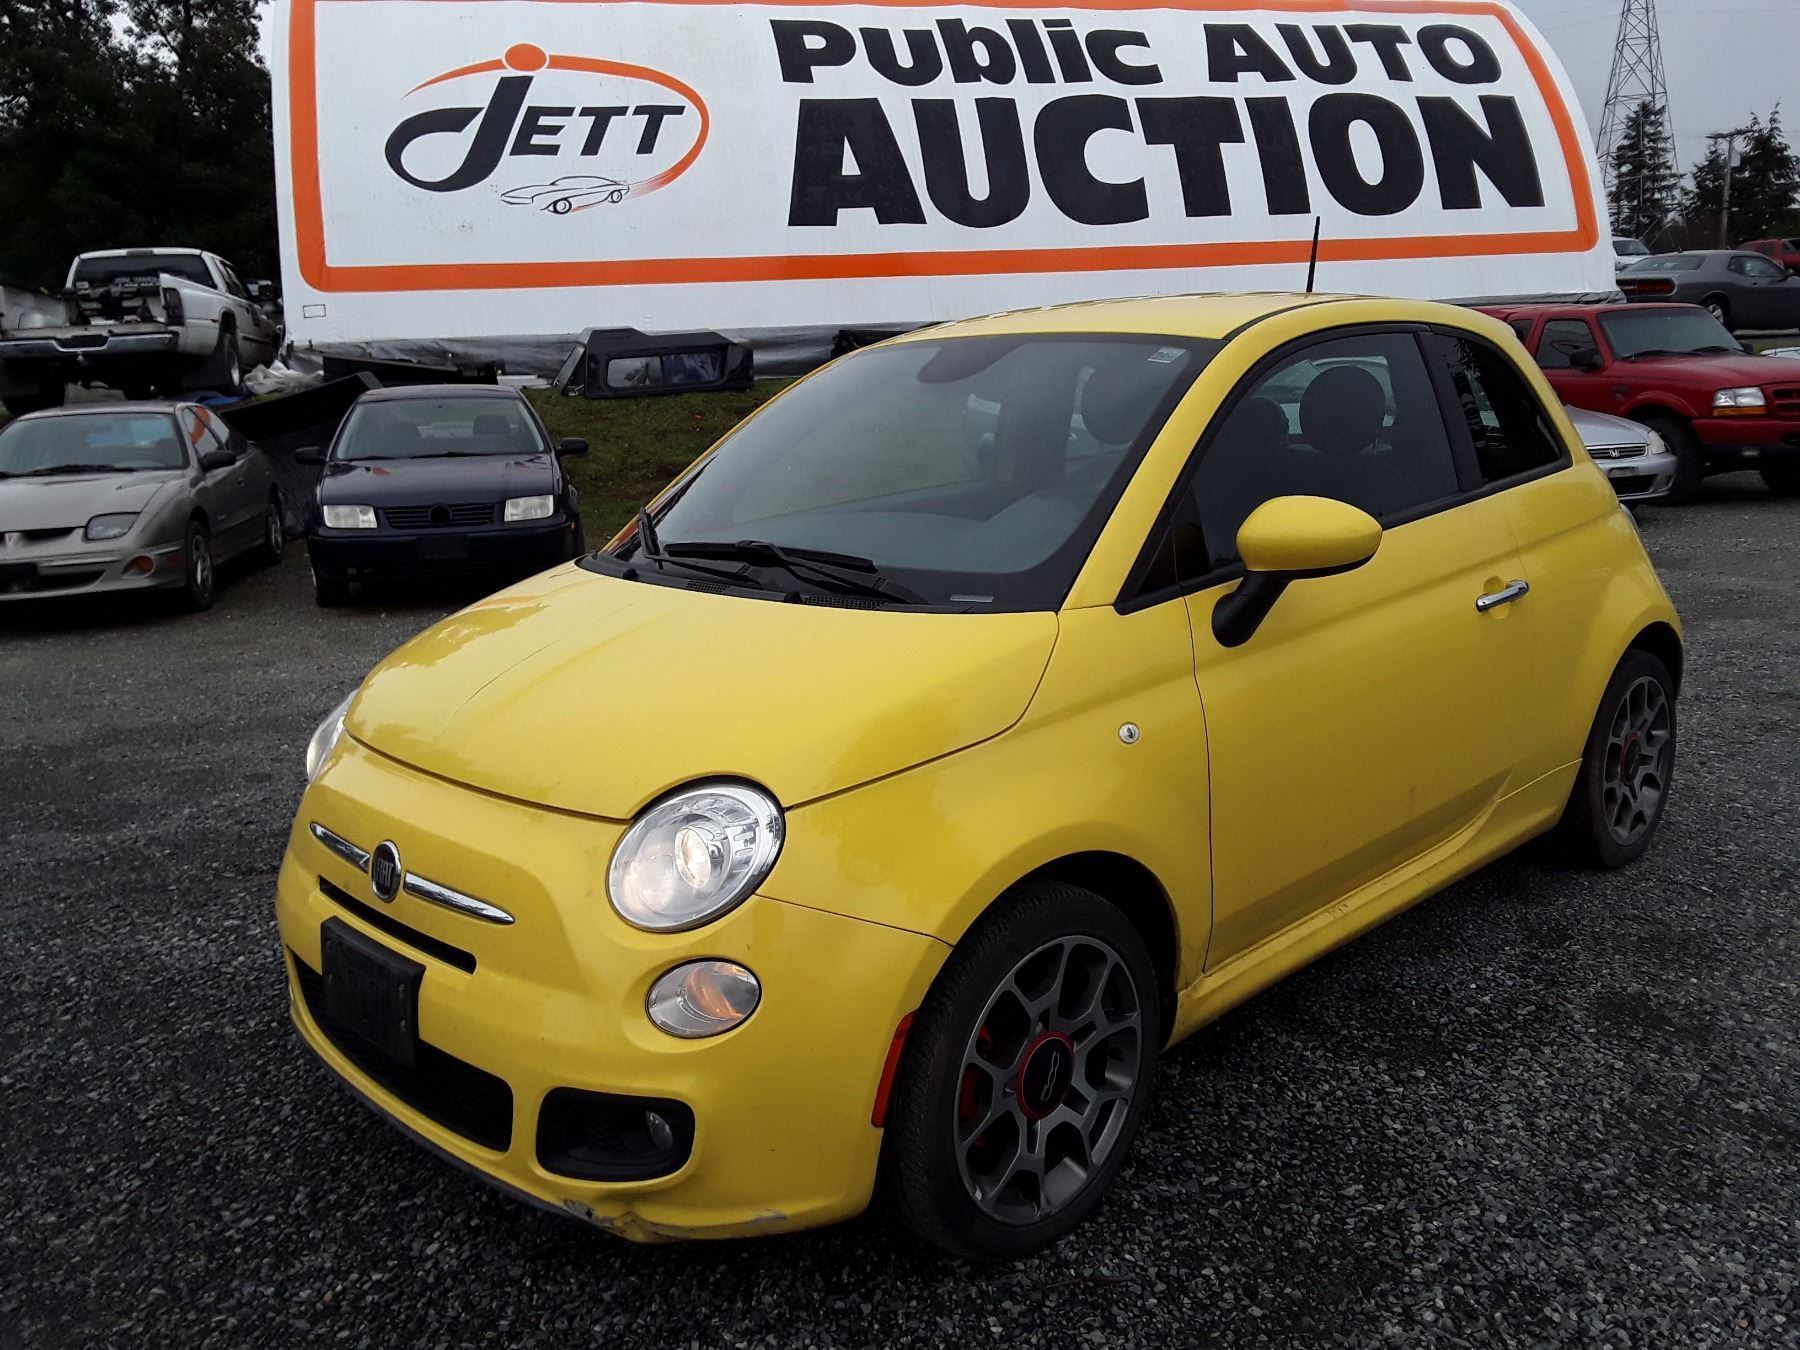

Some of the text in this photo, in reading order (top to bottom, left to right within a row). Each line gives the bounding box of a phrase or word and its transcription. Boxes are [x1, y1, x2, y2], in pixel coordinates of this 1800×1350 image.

[769, 18, 1502, 87] Public AUTO
[384, 75, 686, 193] JETT
[787, 93, 1545, 229] AUCTION
